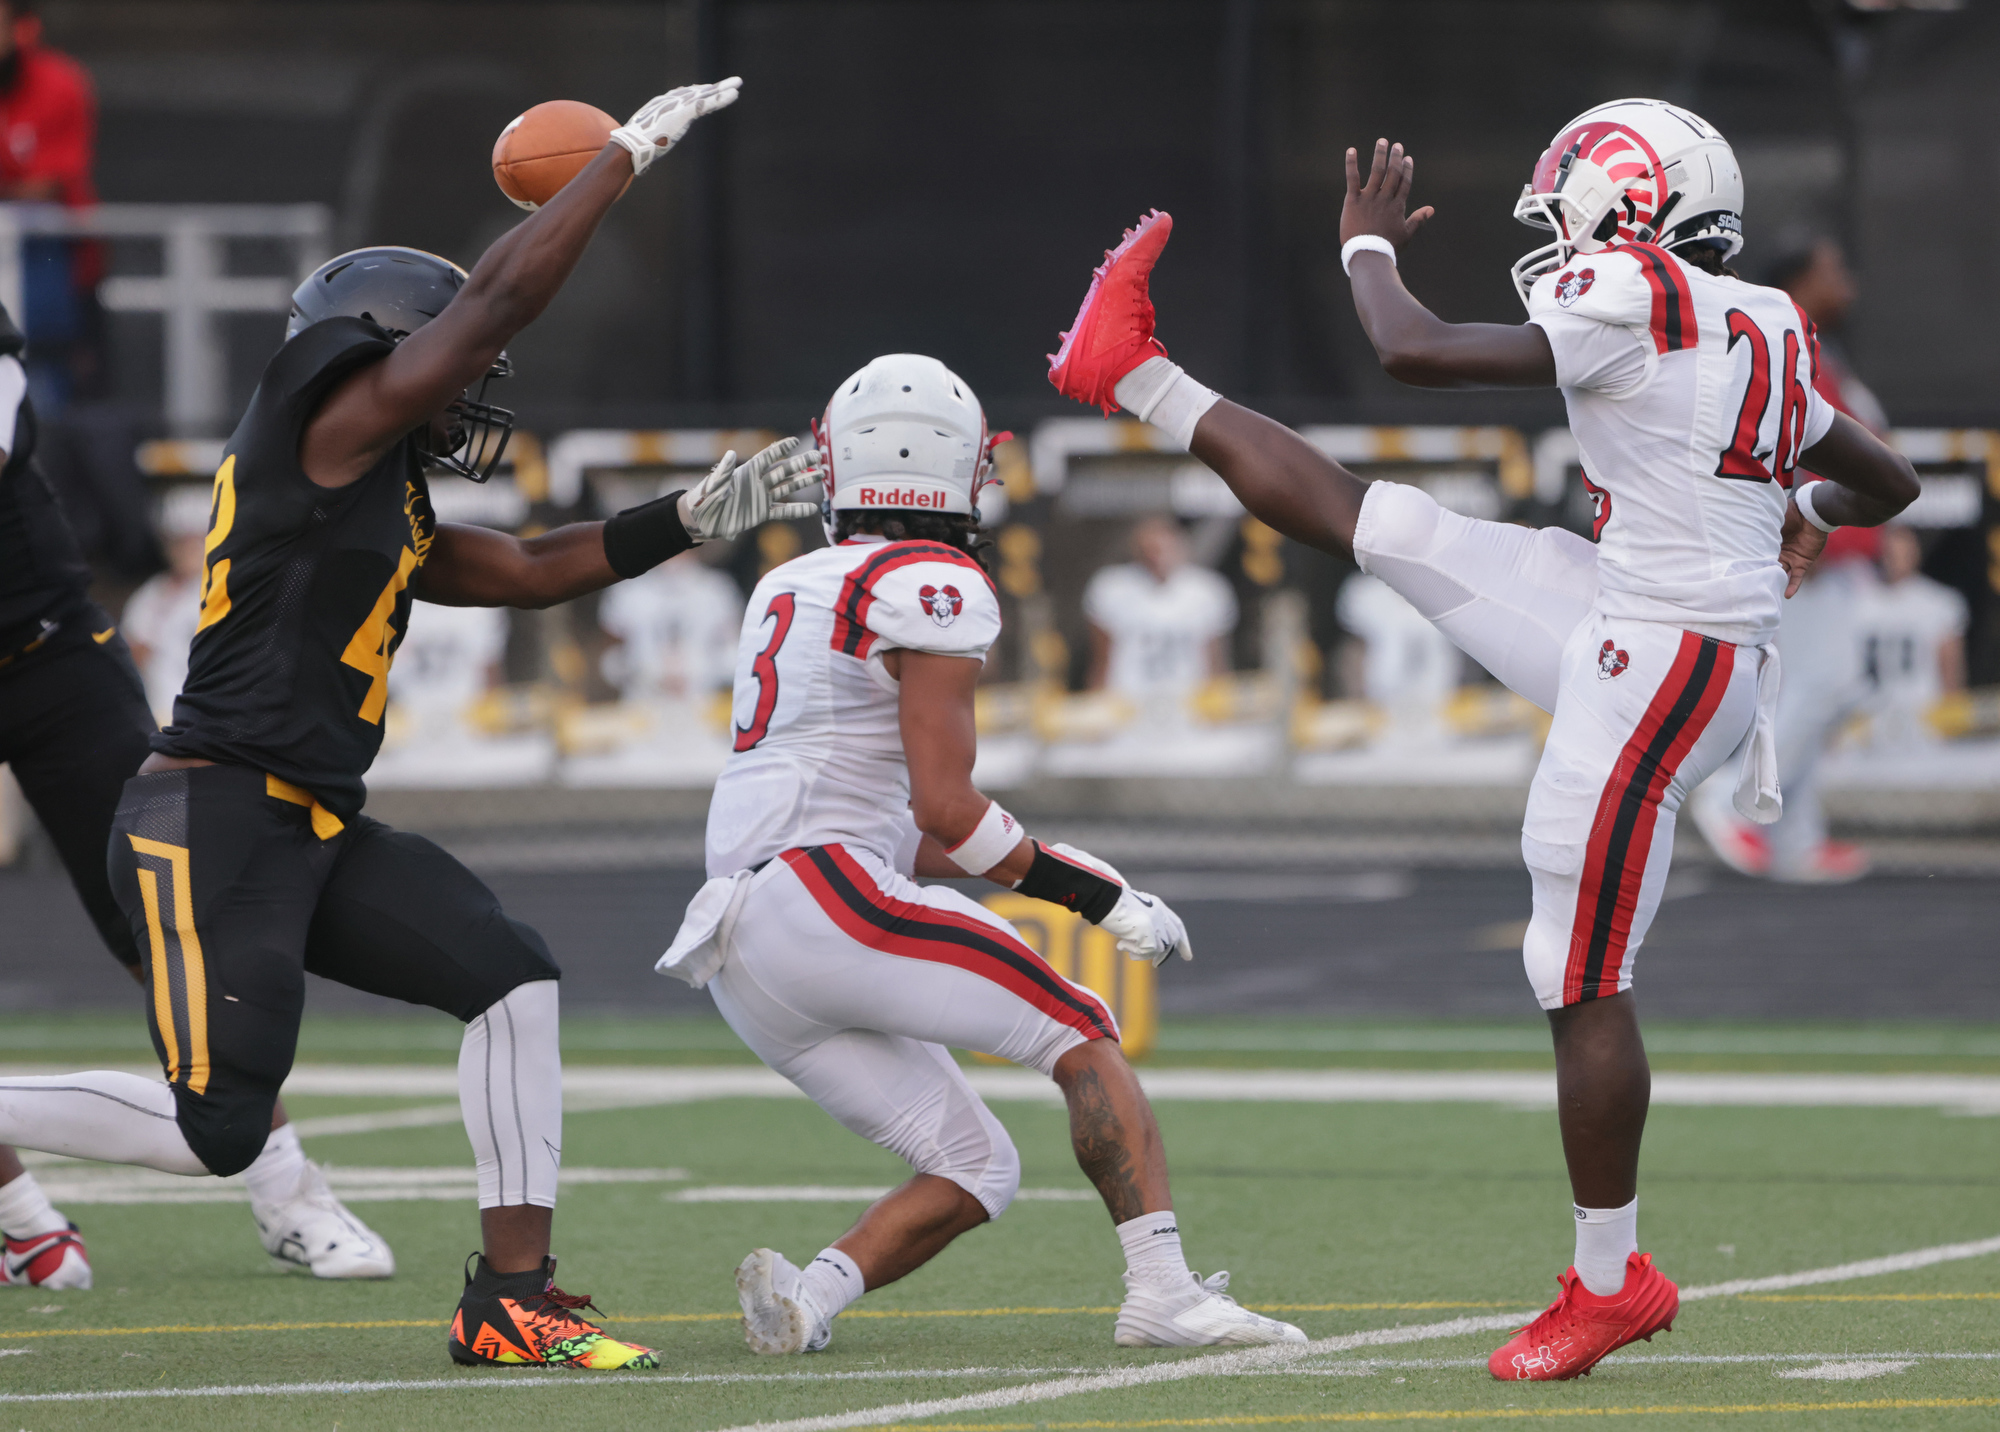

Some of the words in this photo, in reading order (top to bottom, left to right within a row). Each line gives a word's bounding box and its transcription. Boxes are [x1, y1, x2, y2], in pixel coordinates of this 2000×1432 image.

[1714, 307, 1807, 489] 26
[860, 488, 946, 509] Riddell
[734, 591, 796, 752] 3
